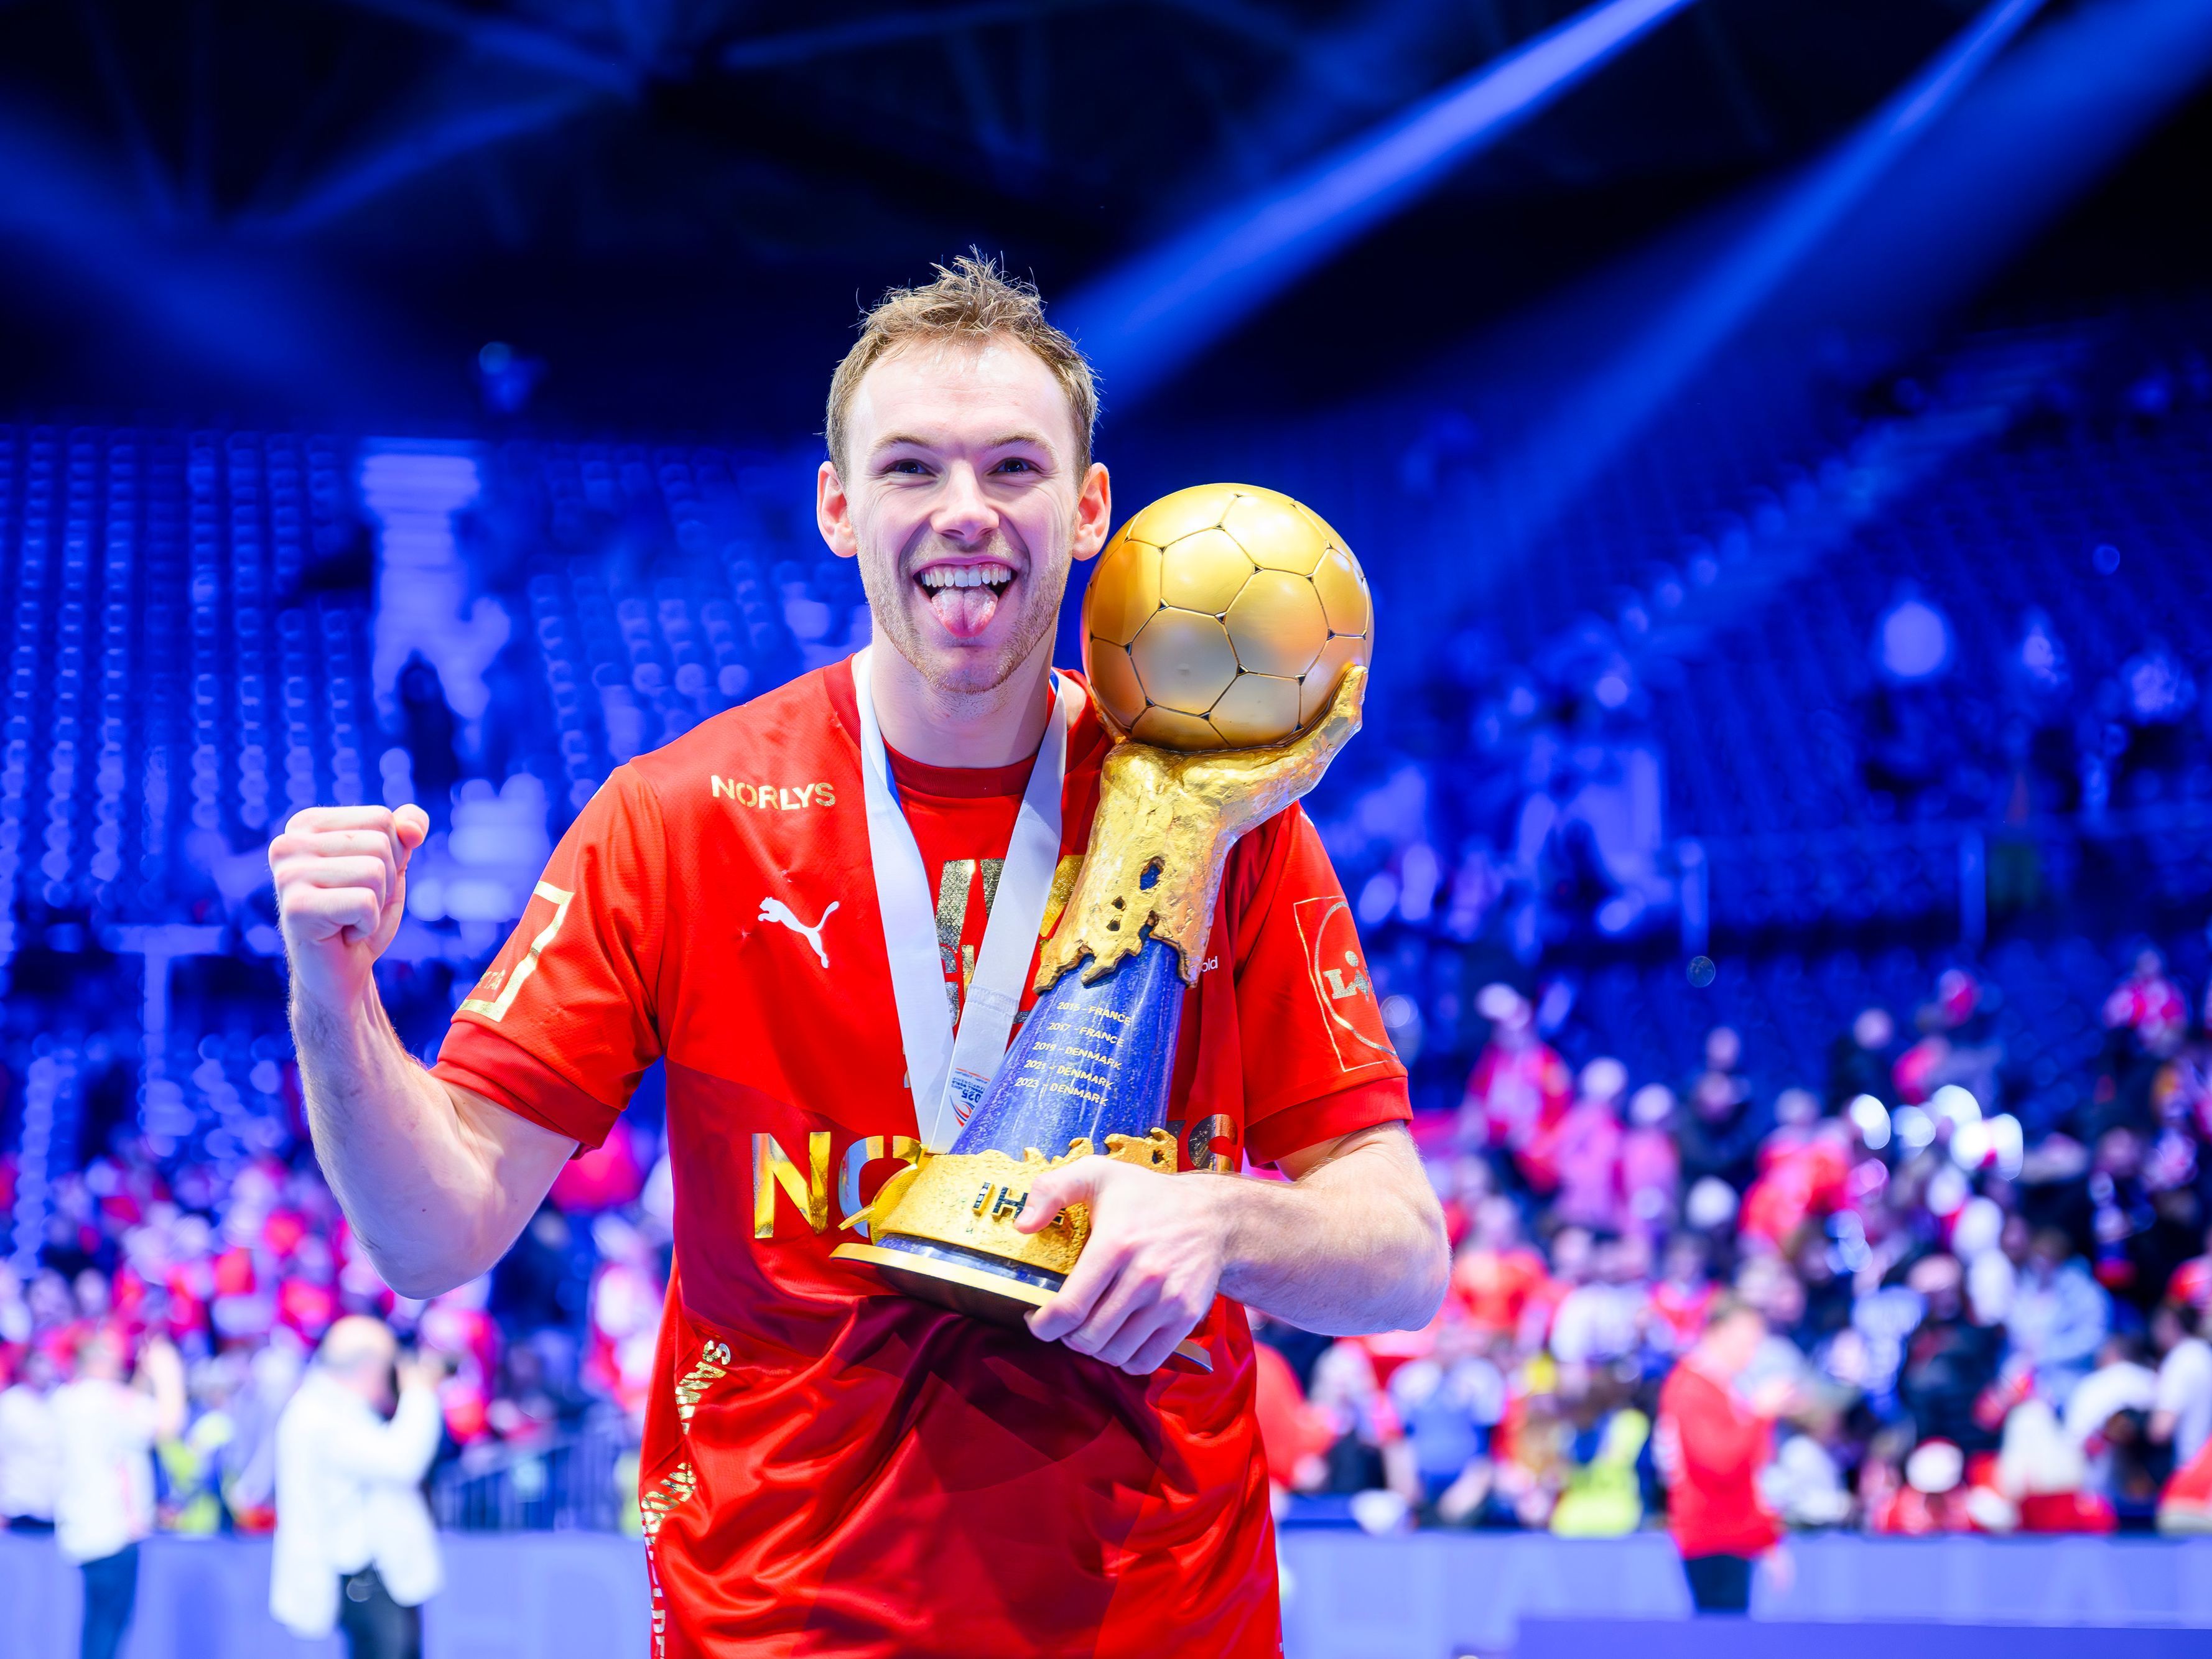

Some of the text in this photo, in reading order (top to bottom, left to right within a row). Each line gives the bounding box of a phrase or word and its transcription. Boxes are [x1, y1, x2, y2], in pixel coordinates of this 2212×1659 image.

[710, 775, 836, 811] NORLYS
[1202, 955, 1218, 972] old
[1057, 1001, 1081, 1011] 2015
[1087, 1005, 1133, 1026] FRANCE
[1048, 1022, 1071, 1031] 2017
[1079, 1027, 1125, 1048] FRANCE
[1032, 1041, 1056, 1051] 2019
[1064, 1046, 1122, 1070] DENMARK
[1024, 1059, 1046, 1070] 2021
[1056, 1065, 1115, 1090] DENMARK
[961, 1089, 982, 1104] 025
[1015, 1077, 1039, 1088] 2023
[1049, 1083, 1109, 1107] DENMARK
